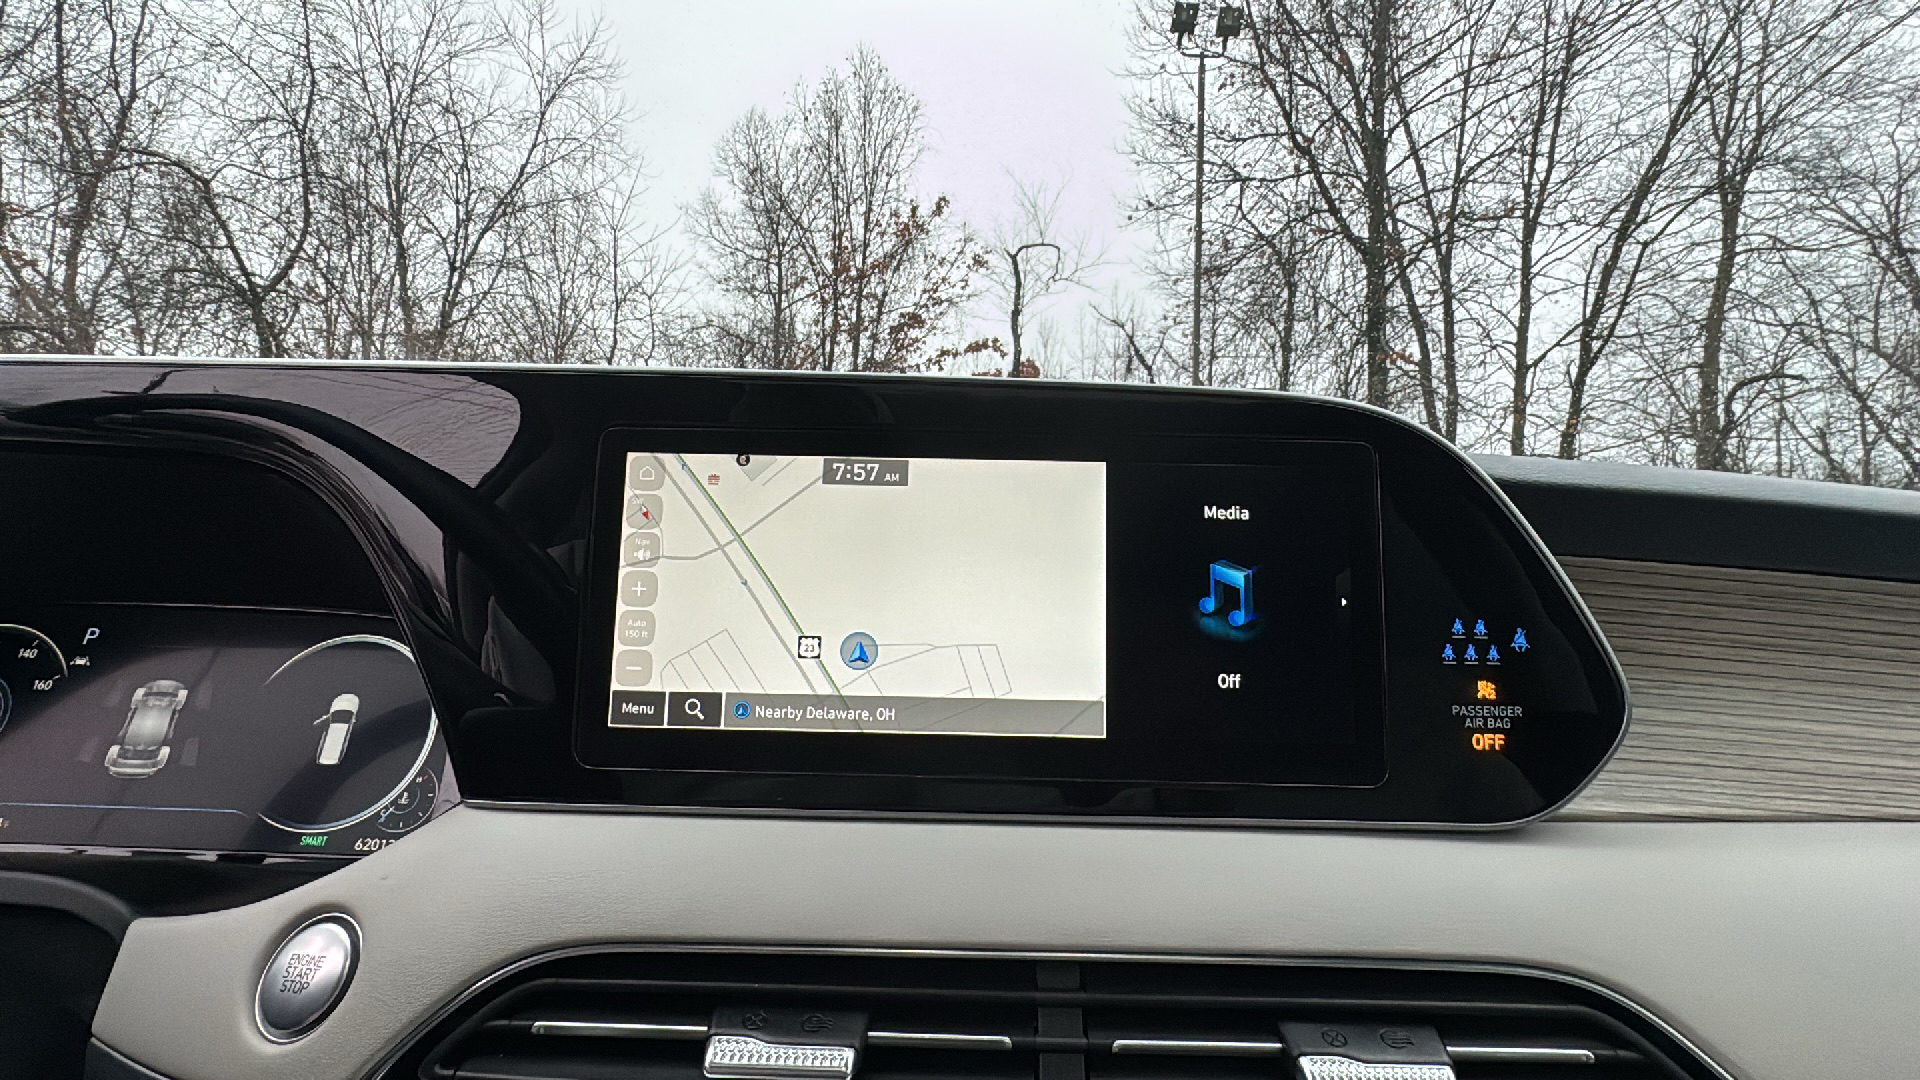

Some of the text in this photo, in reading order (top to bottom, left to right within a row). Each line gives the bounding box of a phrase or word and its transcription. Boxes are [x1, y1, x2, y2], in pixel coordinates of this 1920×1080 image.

[832, 462, 900, 482] 7:57 AM
[1203, 505, 1250, 520] Media
[635, 537, 651, 546] Nav
[627, 619, 647, 627] Auto
[82, 627, 100, 645] P
[625, 629, 640, 638] 150
[18, 647, 39, 659] 140
[803, 643, 815, 653] 23
[32, 679, 53, 691] 160
[1217, 673, 1241, 689] Off
[621, 702, 655, 715] Menu
[755, 705, 896, 722] Nearby Delaware, OH
[1451, 705, 1523, 717] PASSENGER
[1464, 717, 1511, 729] AIR BAG
[1471, 733, 1506, 751] OFF
[300, 835, 329, 847] SMART
[288, 953, 326, 968] ENGINE
[282, 966, 321, 982] START
[279, 979, 310, 994] STOP
